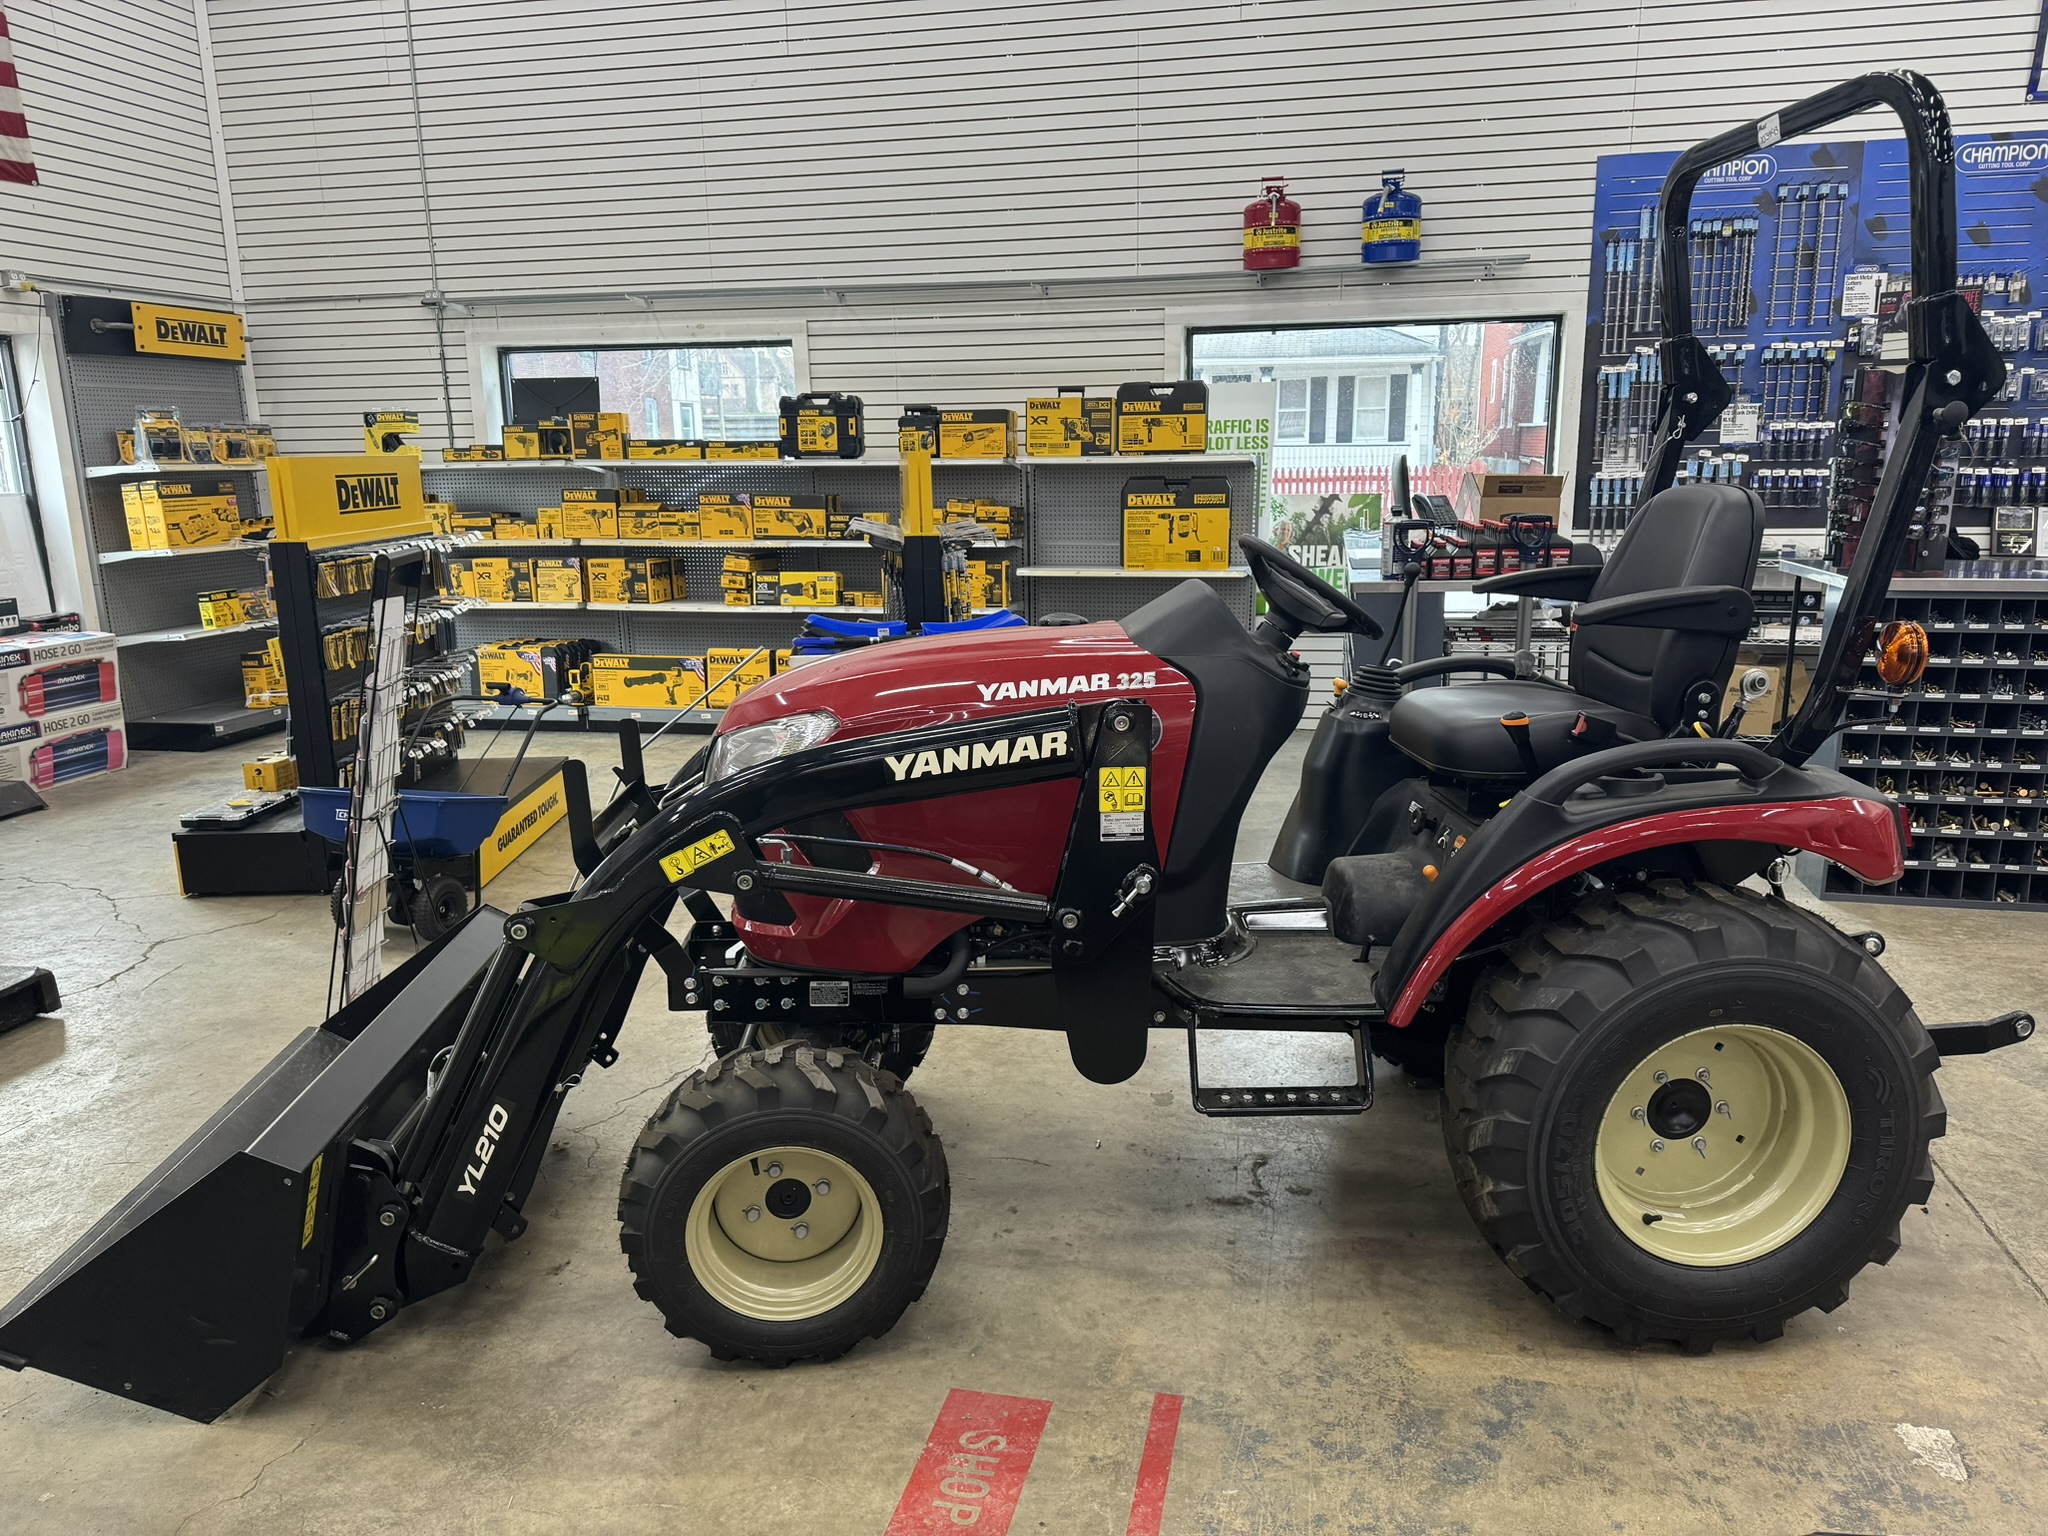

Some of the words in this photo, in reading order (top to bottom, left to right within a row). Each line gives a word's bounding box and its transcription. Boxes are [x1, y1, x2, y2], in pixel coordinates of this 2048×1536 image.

[1703, 159, 1769, 177] AMPION
[1262, 227, 1287, 235] Justrite
[1377, 220, 1403, 228] Justrite
[1030, 416, 1048, 425] XR
[1208, 419, 1251, 434] RAFFIC
[1256, 419, 1269, 433] IS
[1237, 436, 1269, 450] LESS
[1288, 545, 1348, 567] SHEA
[477, 572, 492, 580] XR
[592, 572, 607, 581] XR
[0, 653, 21, 663] INEX
[34, 648, 59, 661] HOSE
[61, 646, 67, 656] 2
[68, 644, 81, 655] GO
[977, 673, 1110, 702] YANMAR
[1116, 672, 1156, 690] 325
[43, 718, 69, 733] HOSE
[71, 717, 77, 727] 2
[78, 714, 90, 725] GO
[0, 726, 32, 739] AKINEX
[885, 731, 1067, 781] YANMAR
[497, 809, 538, 852] GUARANTEED
[457, 1103, 509, 1196] YL210
[931, 1429, 1007, 1527] SHOP
